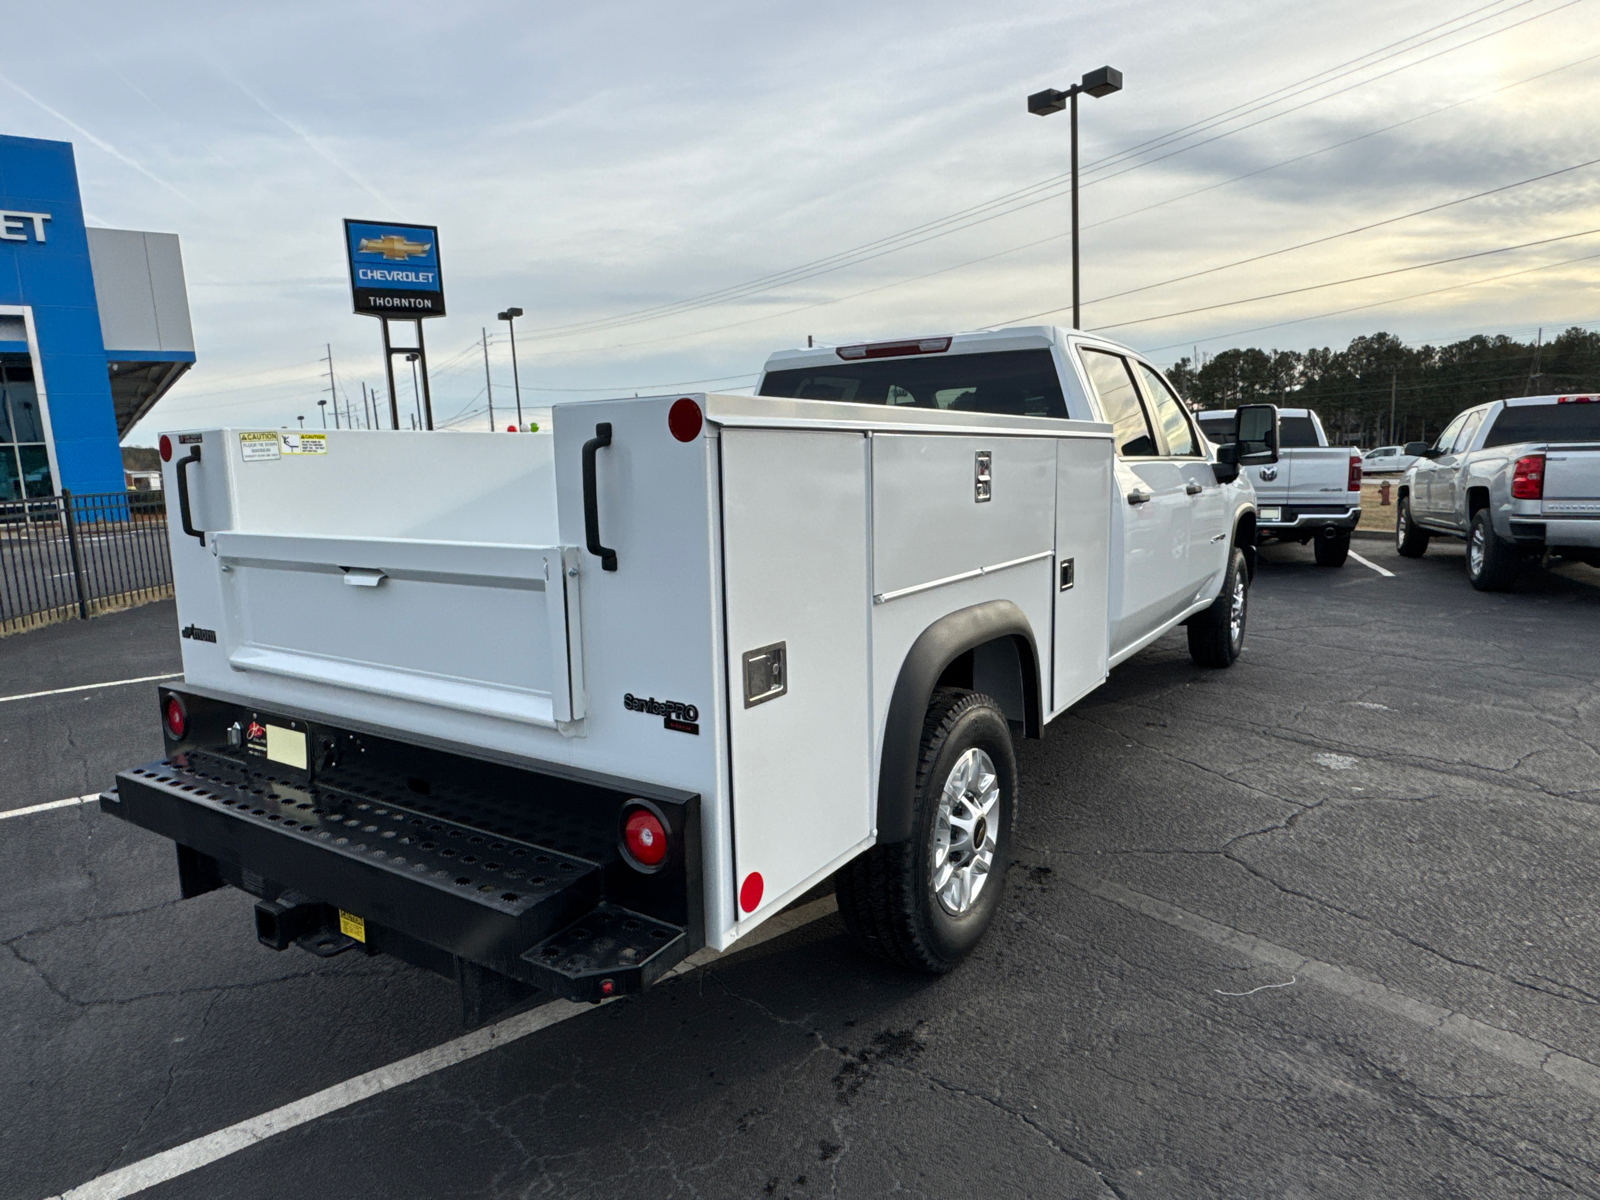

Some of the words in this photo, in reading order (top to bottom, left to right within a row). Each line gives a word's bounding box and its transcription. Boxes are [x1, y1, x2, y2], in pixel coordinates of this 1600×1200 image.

[359, 269, 434, 283] CHEVROLET
[368, 296, 432, 308] THORNTON
[247, 433, 277, 441] CAUTION
